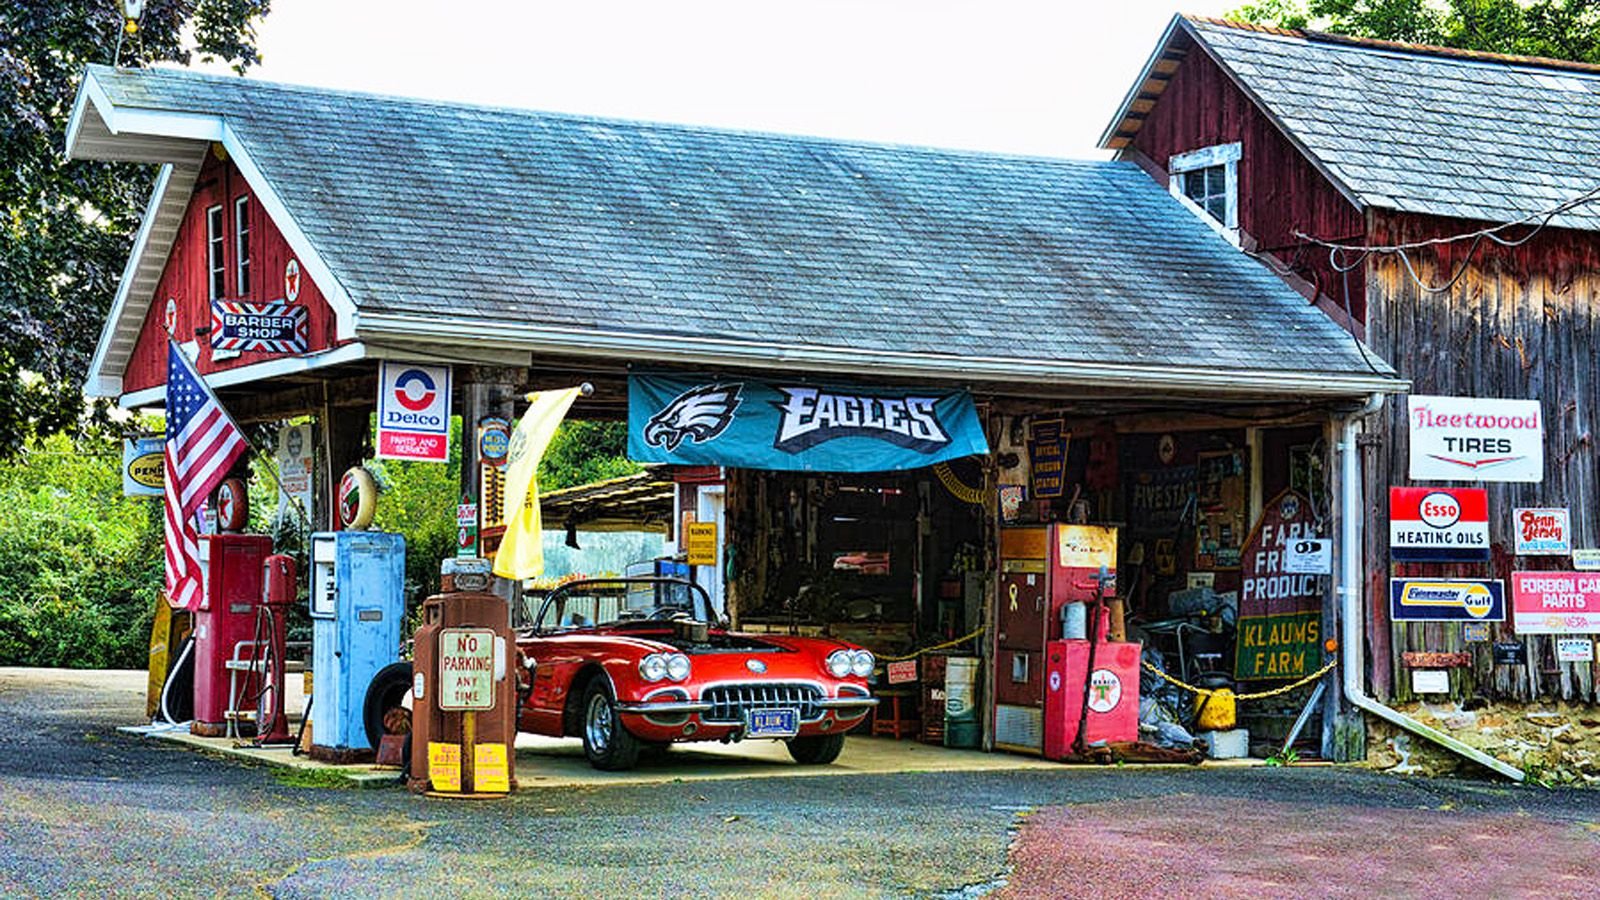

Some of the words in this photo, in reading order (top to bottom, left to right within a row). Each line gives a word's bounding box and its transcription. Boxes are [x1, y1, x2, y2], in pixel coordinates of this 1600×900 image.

[225, 316, 293, 329] BARBER
[238, 327, 281, 338] SHOP
[388, 412, 440, 425] Delco
[775, 386, 950, 445] EAGLES
[1413, 405, 1537, 429] Fleetwood
[391, 436, 417, 445] PARTS
[419, 439, 438, 447] AND
[1443, 437, 1512, 453] TIRES
[1397, 531, 1453, 544] HEATING
[1456, 532, 1484, 545] OILS
[1521, 579, 1575, 594] FOREIGN
[1465, 594, 1491, 606] Gulf
[1543, 593, 1586, 609] PARTS
[1244, 621, 1319, 648] KLAUMS
[457, 638, 478, 652] NO
[444, 656, 491, 672] PARKING
[1254, 651, 1306, 675] FARM
[456, 677, 478, 687] ANY
[455, 692, 479, 702] TIME
